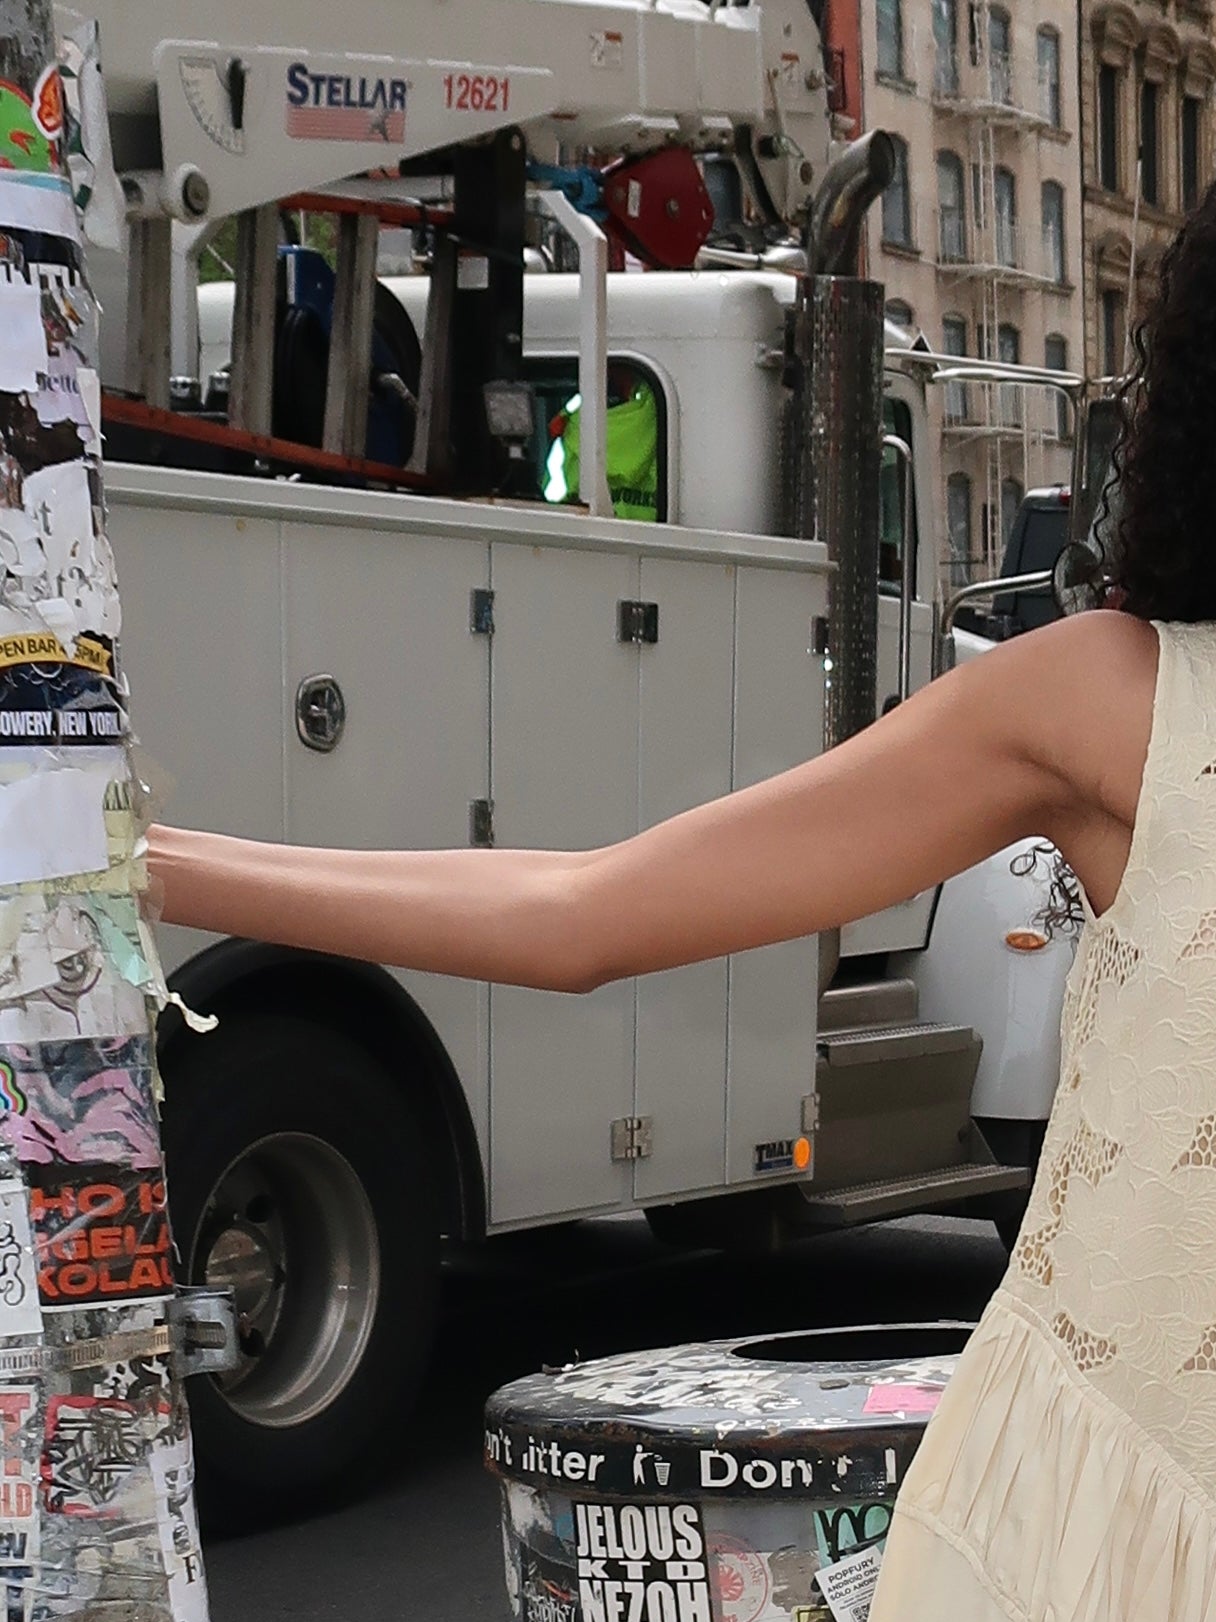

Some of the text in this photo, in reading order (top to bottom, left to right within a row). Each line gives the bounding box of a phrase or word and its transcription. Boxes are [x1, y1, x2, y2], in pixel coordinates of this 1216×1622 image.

[444, 73, 509, 112] 12621
[28, 637, 57, 654] BAR
[576, 1503, 702, 1560] JELOUS
[828, 1557, 875, 1583] POPFURY
